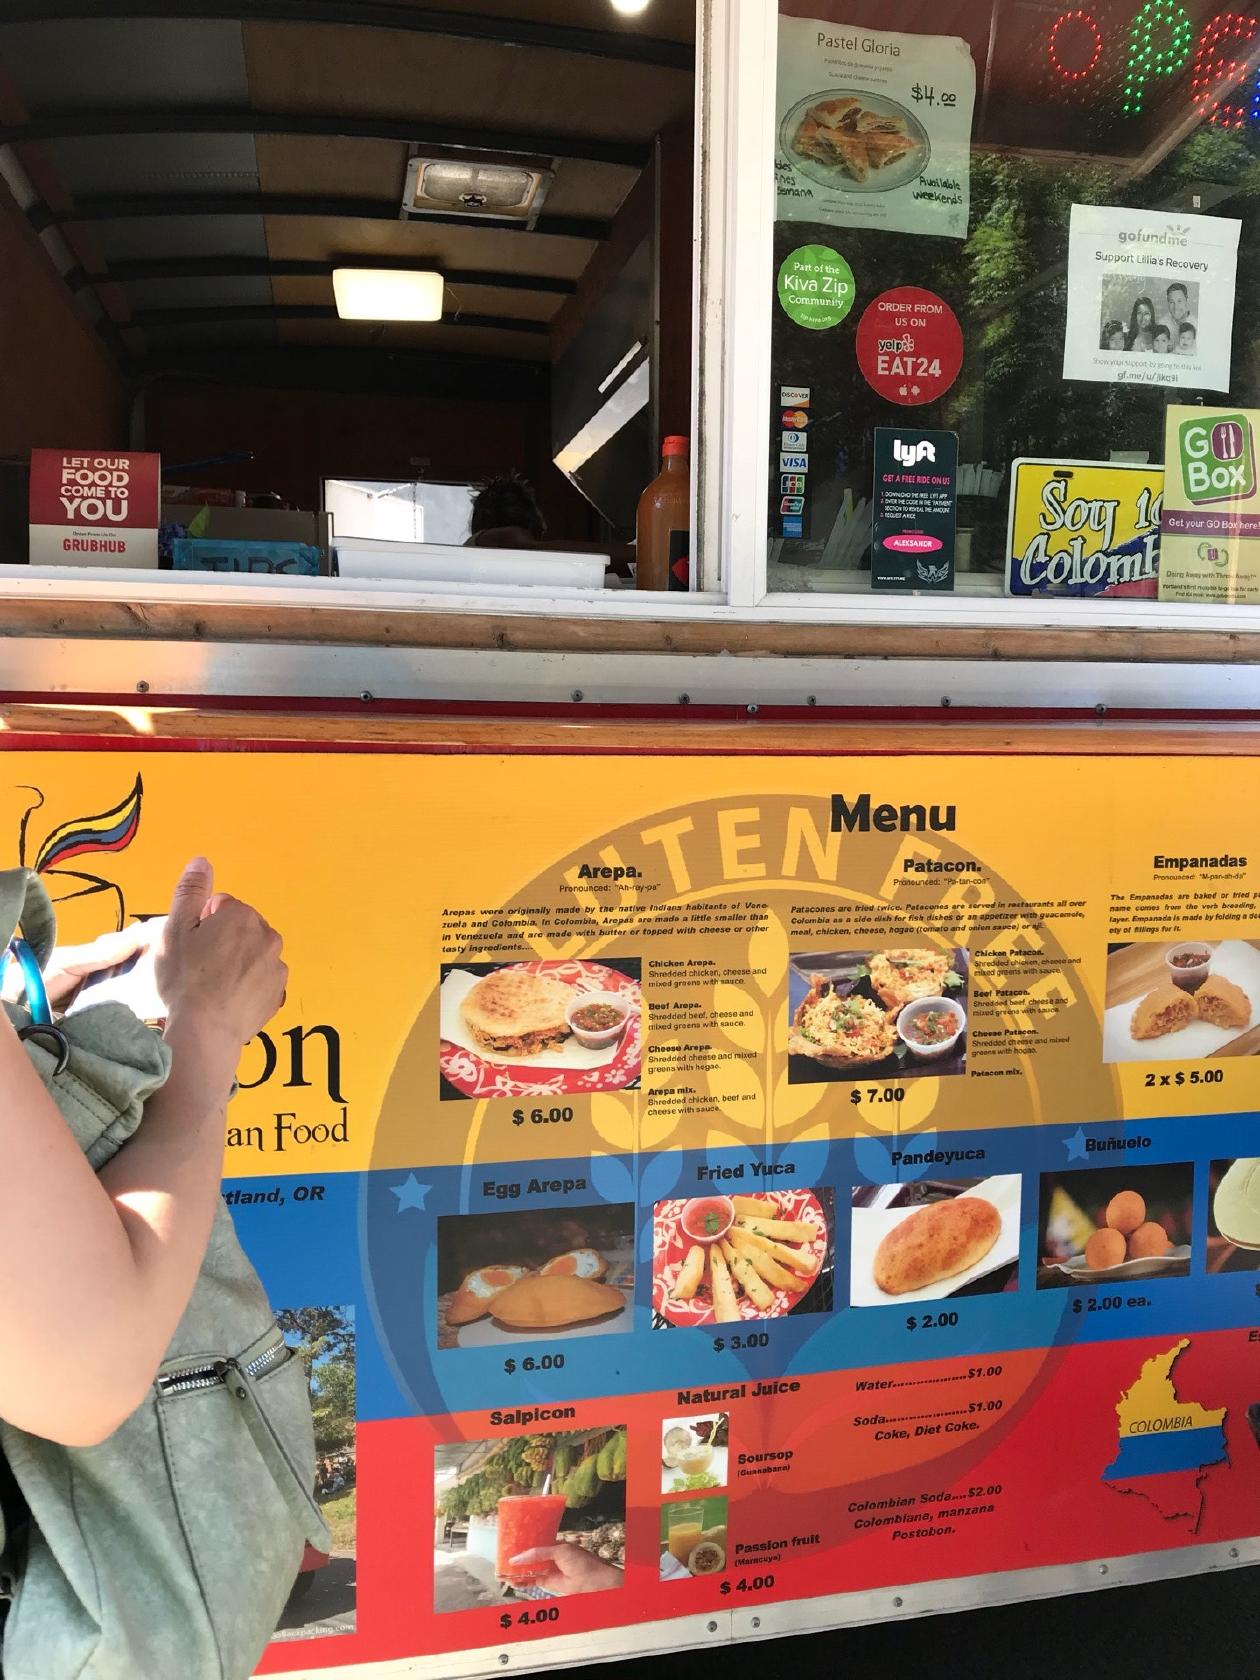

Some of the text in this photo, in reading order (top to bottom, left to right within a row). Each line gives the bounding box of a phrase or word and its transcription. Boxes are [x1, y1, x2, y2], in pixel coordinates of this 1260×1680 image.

[817, 32, 900, 56] Pastel Gloria
[911, 83, 956, 106] $4.00
[919, 176, 961, 191] Available
[1118, 229, 1188, 246] gofundme
[794, 262, 840, 274] Part of the
[1095, 251, 1134, 264] Support
[1166, 258, 1209, 272] Recovery
[784, 275, 848, 298] Kiva Zip
[788, 295, 844, 308] Community
[878, 302, 943, 314] ORDER FROM
[895, 318, 926, 327] US ON
[878, 338, 903, 354] yelp
[877, 356, 942, 377] EAT24
[893, 439, 936, 467] lyft
[62, 457, 129, 470] LET OUR
[782, 457, 807, 468] VISA
[61, 470, 129, 486] FOOD
[902, 475, 915, 483] FREE
[916, 476, 930, 484] RIDE
[931, 476, 942, 484] ON
[61, 486, 129, 498] COME TO
[60, 498, 129, 521] YOU
[1039, 478, 1120, 551] Soy
[1169, 518, 1184, 528] Get
[1186, 520, 1205, 529] your
[1206, 519, 1220, 529] GO
[1221, 520, 1238, 529] Box
[63, 539, 126, 553] GRUBHUB
[893, 540, 932, 548] ALEKSANDR
[830, 794, 955, 832] Menu
[904, 858, 982, 872] Patacon.
[1153, 854, 1246, 871] Empanadas
[577, 864, 642, 880] Arepa.
[559, 884, 611, 893] Pronounced:
[893, 878, 941, 887] Pronounced:
[508, 907, 550, 916] originally
[584, 906, 595, 914] by
[974, 948, 1044, 958] Chicken Patacon.
[995, 989, 1030, 997] Patacon.
[648, 1002, 669, 1010] Beef
[1145, 1073, 1155, 1086] 2
[1174, 1071, 1184, 1086] $
[1190, 1069, 1223, 1083] 5.00
[850, 1087, 904, 1105] $ 7.00
[512, 1107, 572, 1126] $ 6.00
[274, 1108, 349, 1152] Food
[1085, 1136, 1151, 1151] Buñuelo
[891, 1149, 985, 1166] Pandeyuca
[696, 1160, 794, 1180] Fried Yuca
[293, 1186, 325, 1201] OR
[483, 1178, 586, 1199] Egg Arepa
[1072, 1296, 1150, 1313] $ 2.00 ea.
[906, 1312, 958, 1331] $ 2.00
[713, 1332, 768, 1352] $ 3.00
[504, 1354, 564, 1374] $ 6.00
[677, 1381, 800, 1405] Natural Juice
[490, 1406, 576, 1425] Salpicon
[874, 1421, 979, 1440] Coke, Diet Coke.
[1129, 1415, 1194, 1434] COLOMBIA
[738, 1450, 793, 1464] Soursop
[848, 1497, 915, 1512] Colombian
[854, 1504, 994, 1528] Colombiana, manzana
[892, 1526, 954, 1540] Postobon.
[735, 1534, 819, 1554] Passion fruit
[720, 1574, 774, 1594] $ 4.00
[500, 1607, 559, 1628] $ 4.00
